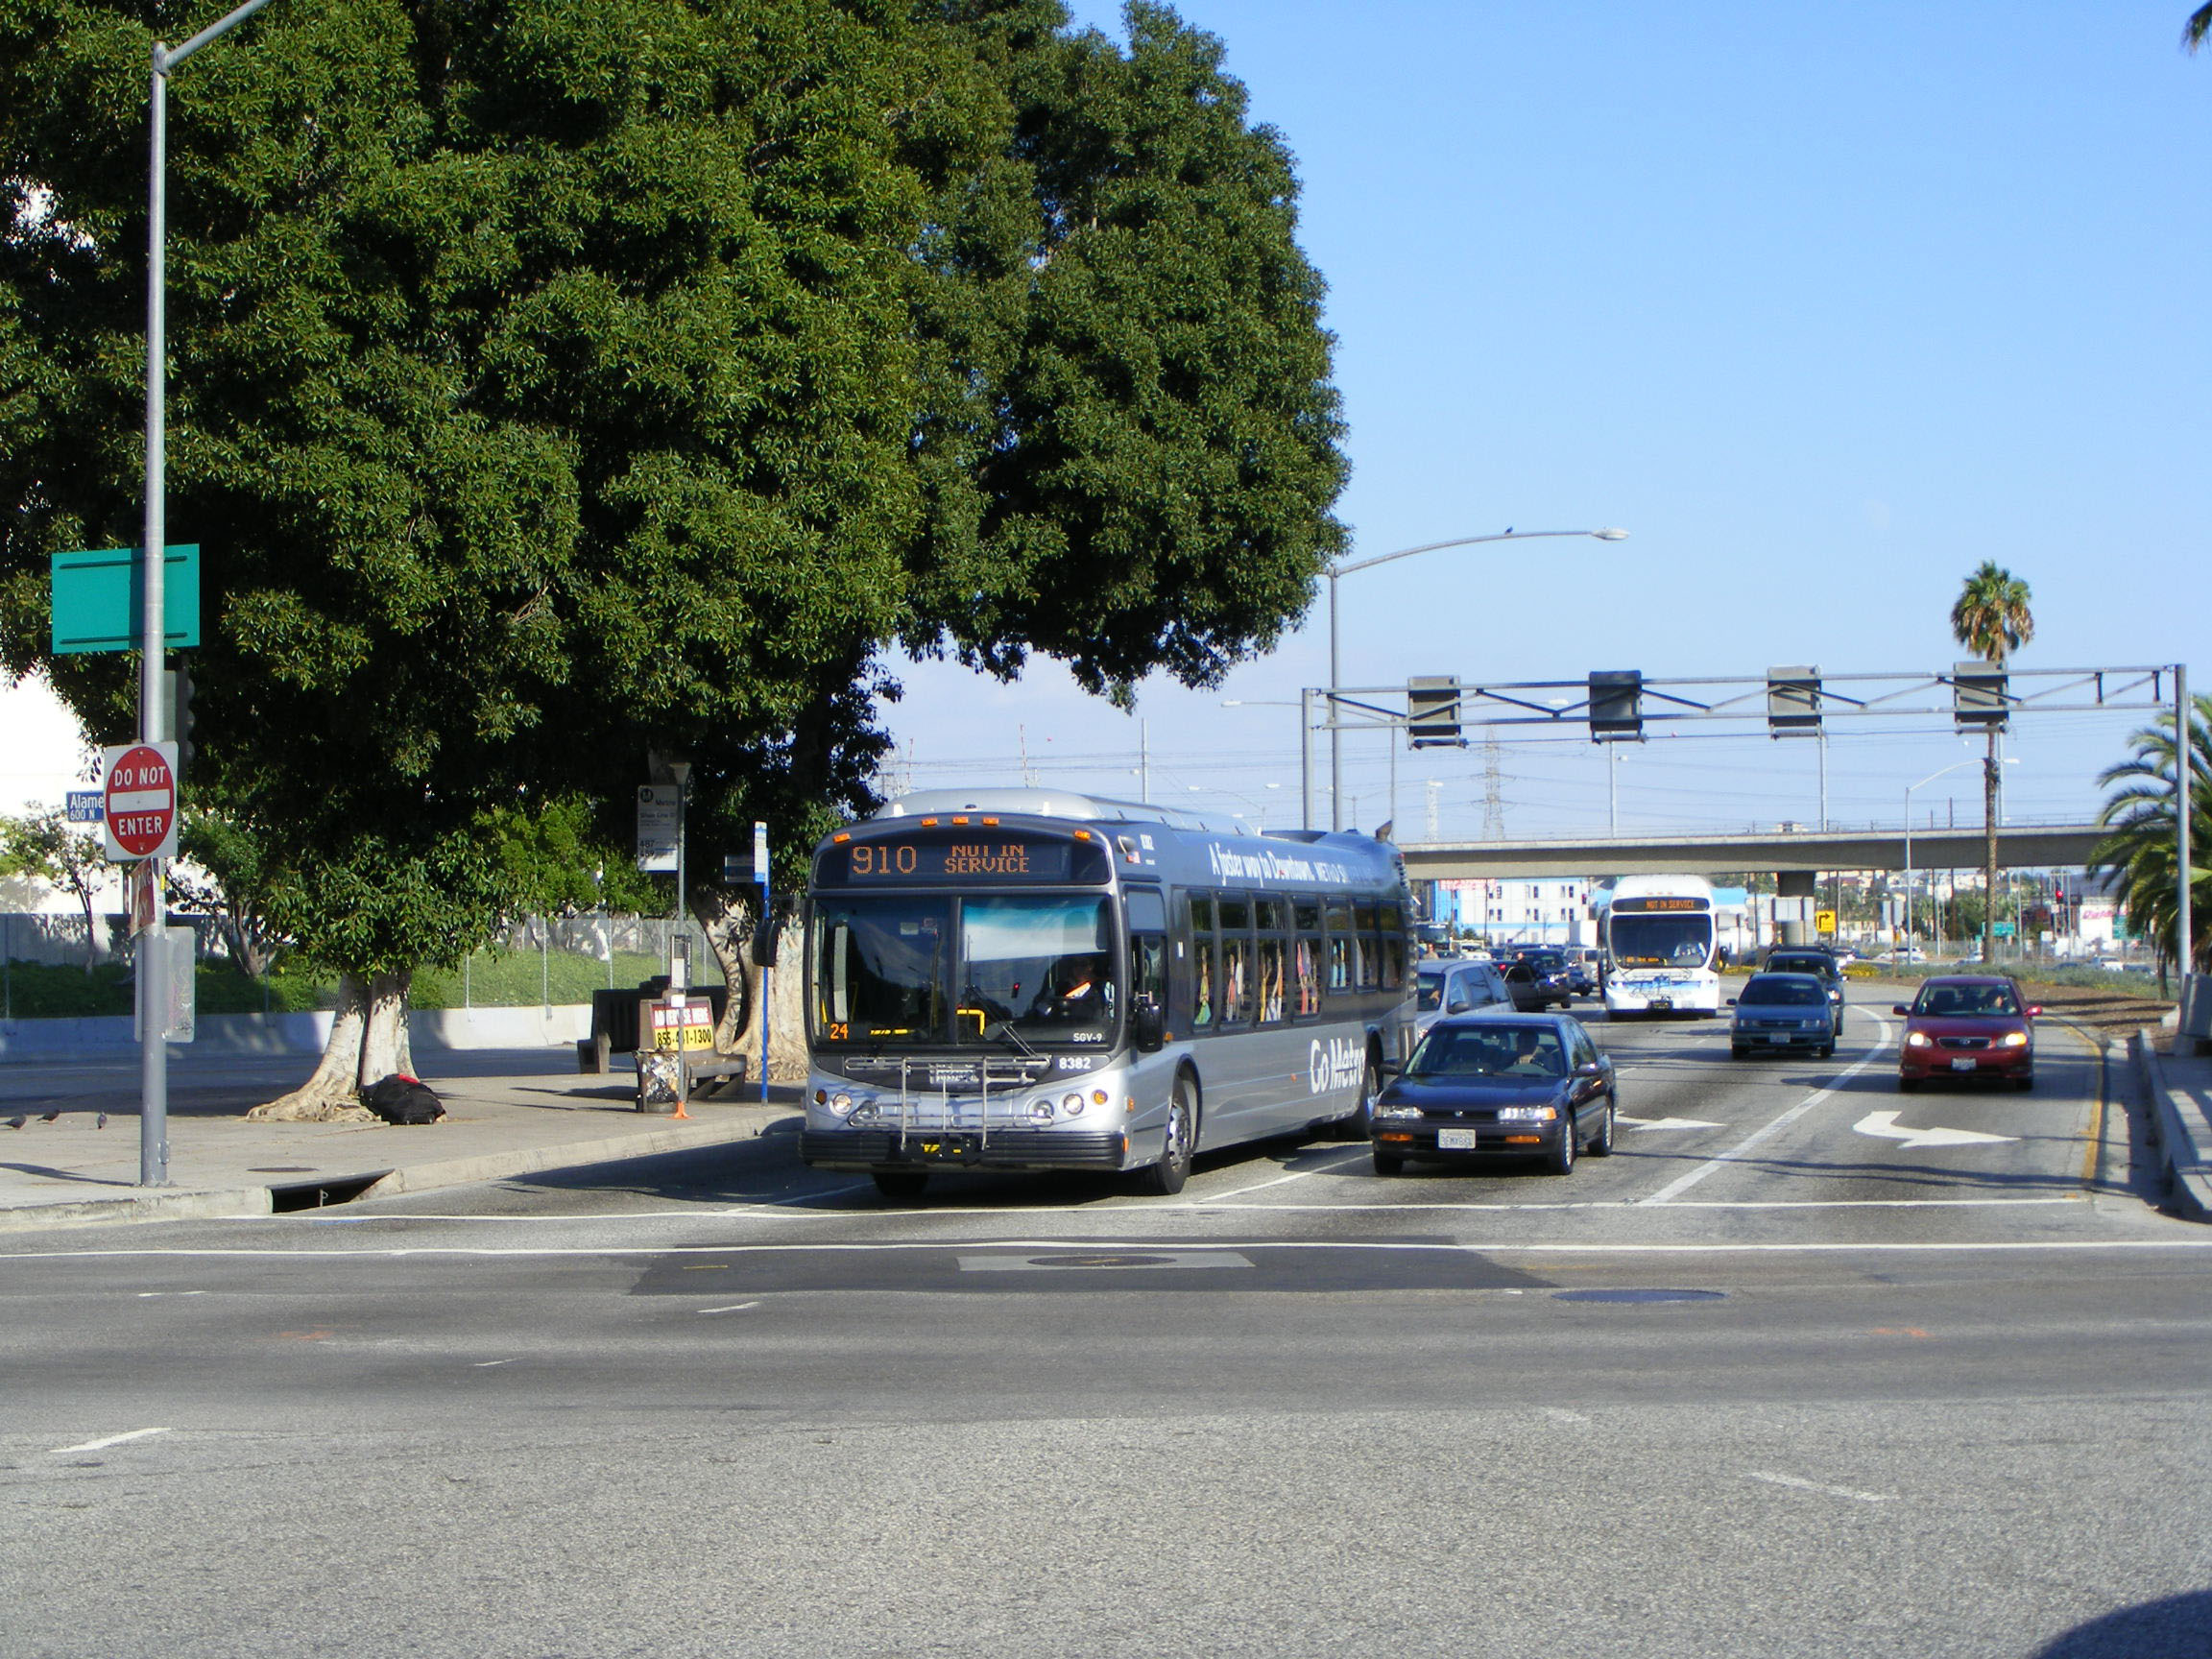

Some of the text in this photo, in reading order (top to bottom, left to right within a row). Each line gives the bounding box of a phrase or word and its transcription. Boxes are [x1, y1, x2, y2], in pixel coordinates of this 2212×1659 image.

[115, 766, 166, 786] DO NOT
[69, 809, 95, 821] 600 N
[118, 816, 163, 836] ENTER
[853, 846, 917, 874] 910
[1000, 845, 1024, 857] IN
[945, 856, 1029, 874] SERVICE
[1208, 844, 1220, 876] A
[1214, 842, 1244, 886] faster
[1242, 853, 1263, 888] way
[1646, 900, 1695, 909] NOT IN SERVICE
[830, 1022, 849, 1040] 24
[1072, 1032, 1103, 1043] SGV-9
[1058, 1057, 1092, 1070] 8382
[1310, 1038, 1365, 1094] Go Metro
